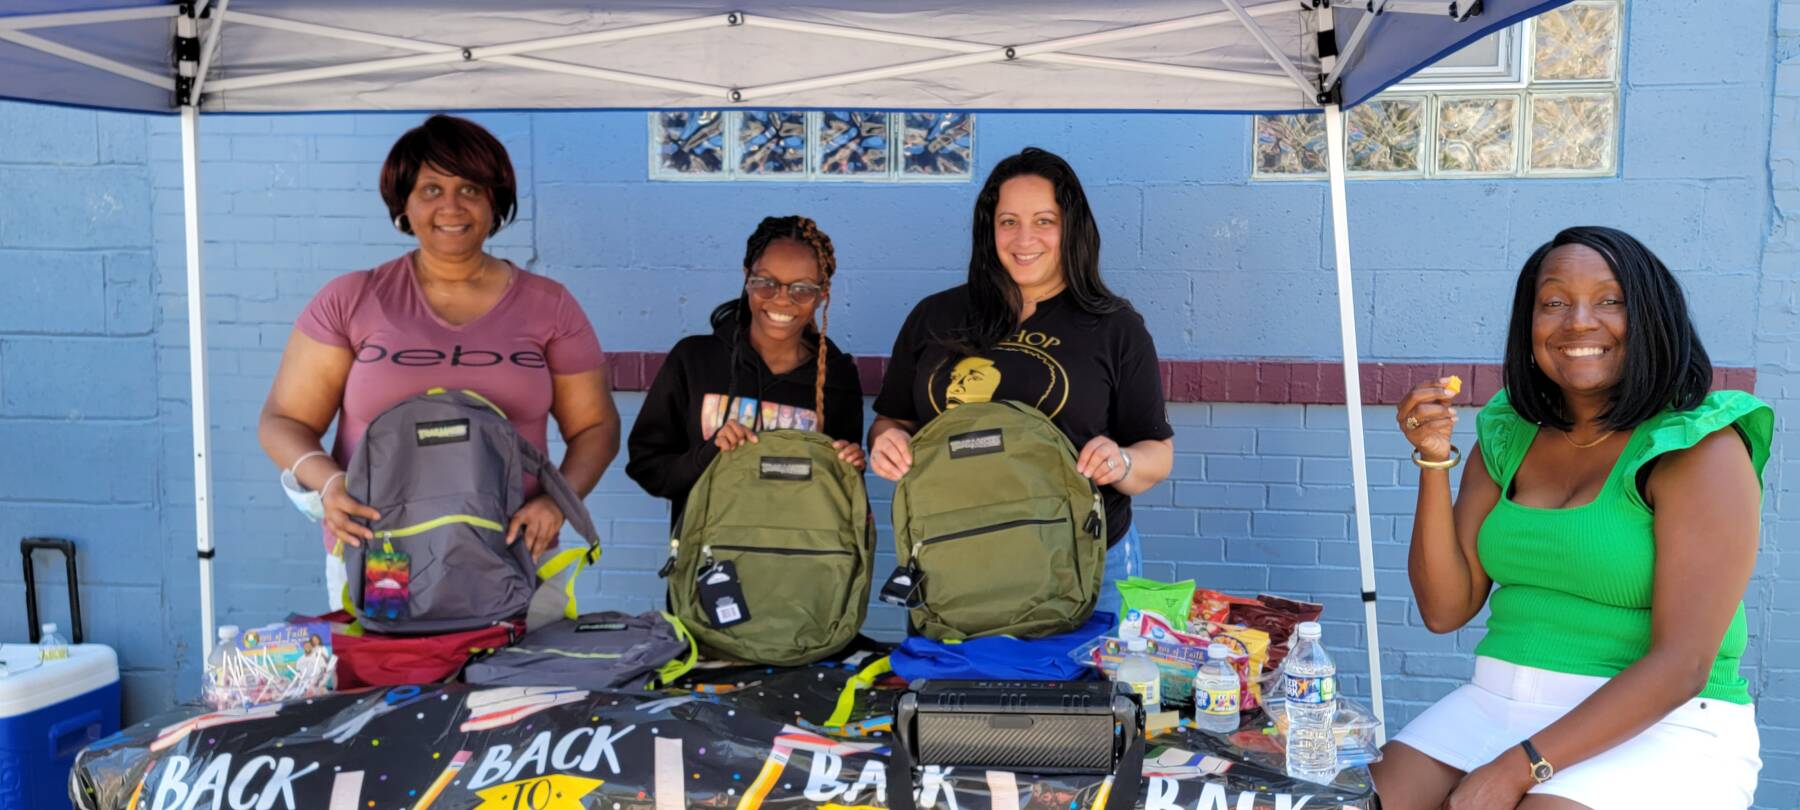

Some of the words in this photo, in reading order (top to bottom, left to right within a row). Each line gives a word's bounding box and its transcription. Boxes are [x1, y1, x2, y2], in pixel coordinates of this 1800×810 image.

[356, 340, 546, 368] bebe
[1008, 329, 1061, 348] HOP
[466, 725, 637, 790] BACK
[803, 750, 960, 810] BAK
[151, 752, 320, 810] BACK
[512, 778, 552, 810] TO
